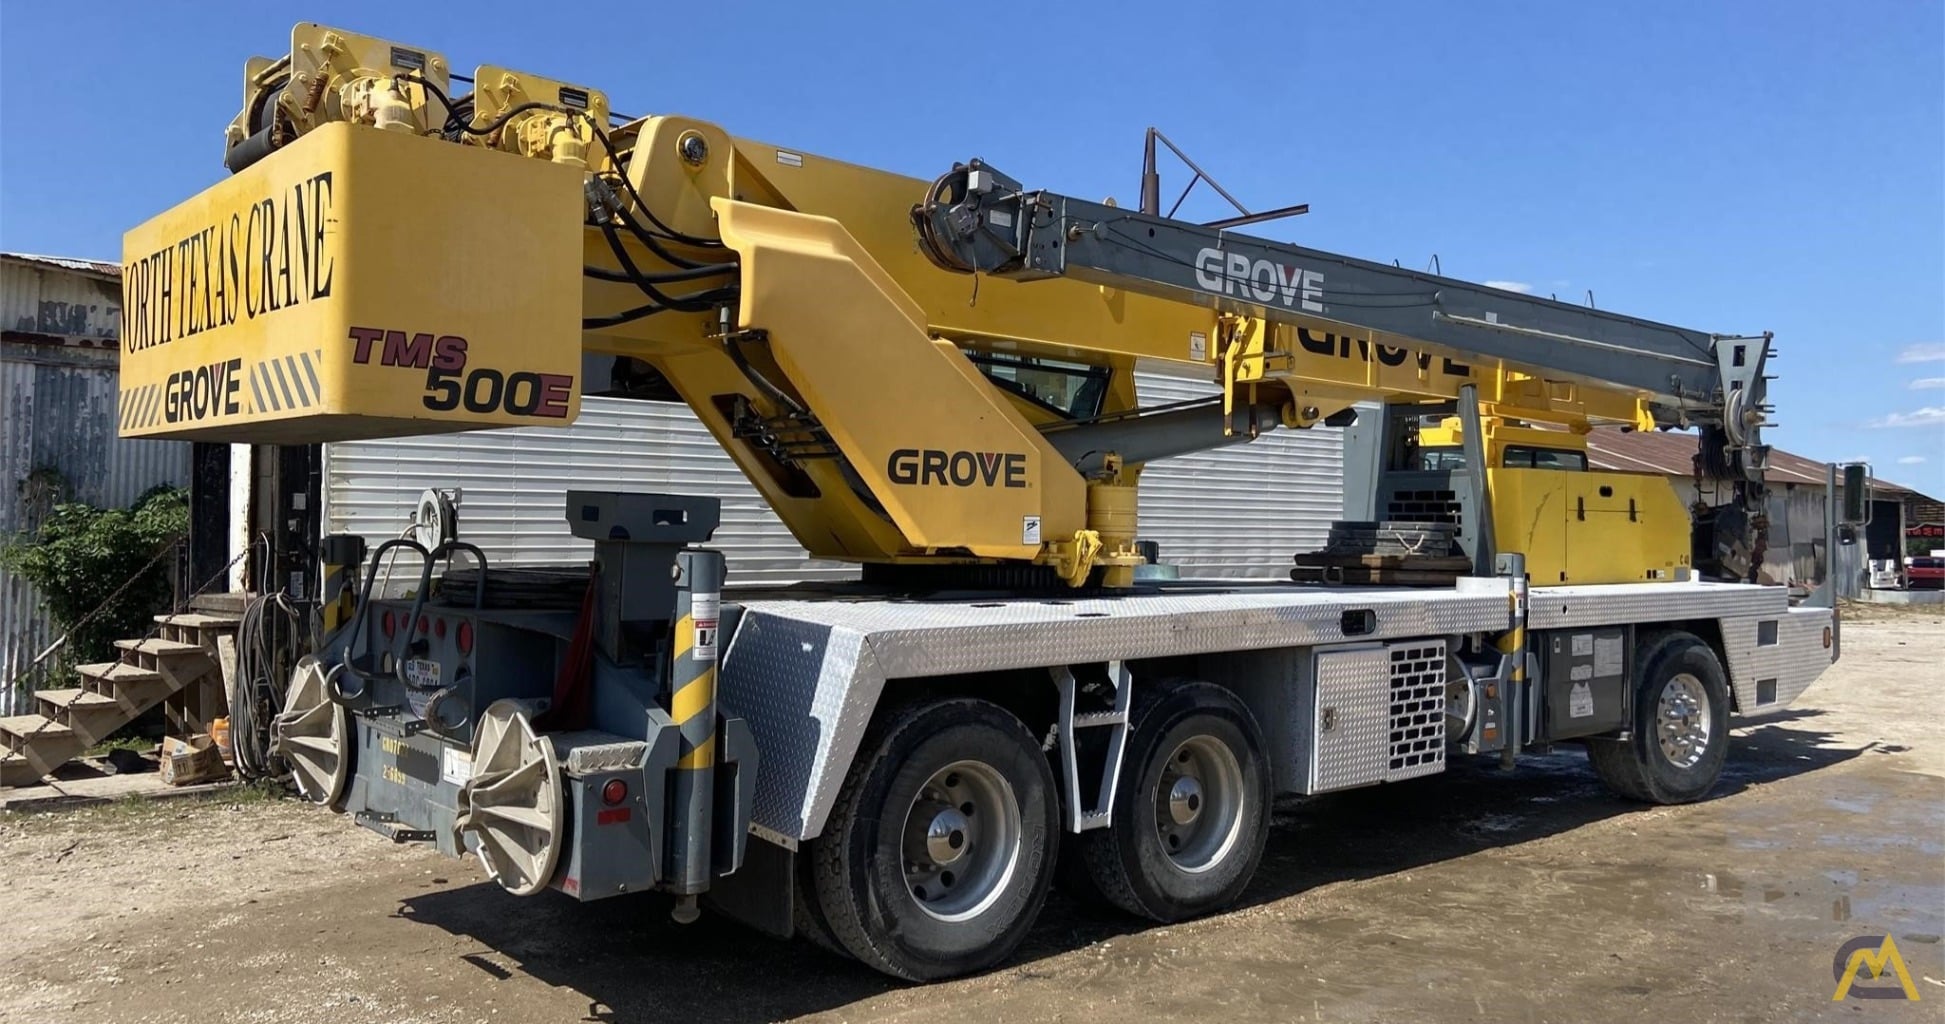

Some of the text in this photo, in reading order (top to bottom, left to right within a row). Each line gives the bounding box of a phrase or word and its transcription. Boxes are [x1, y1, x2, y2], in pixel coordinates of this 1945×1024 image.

[178, 212, 240, 339] TEXAS
[245, 171, 334, 319] CRANE
[1195, 247, 1324, 313] GROVE
[348, 326, 468, 372] TMS
[164, 357, 242, 424] GROVE
[422, 366, 574, 419] 500E
[887, 448, 1026, 488] GROVE
